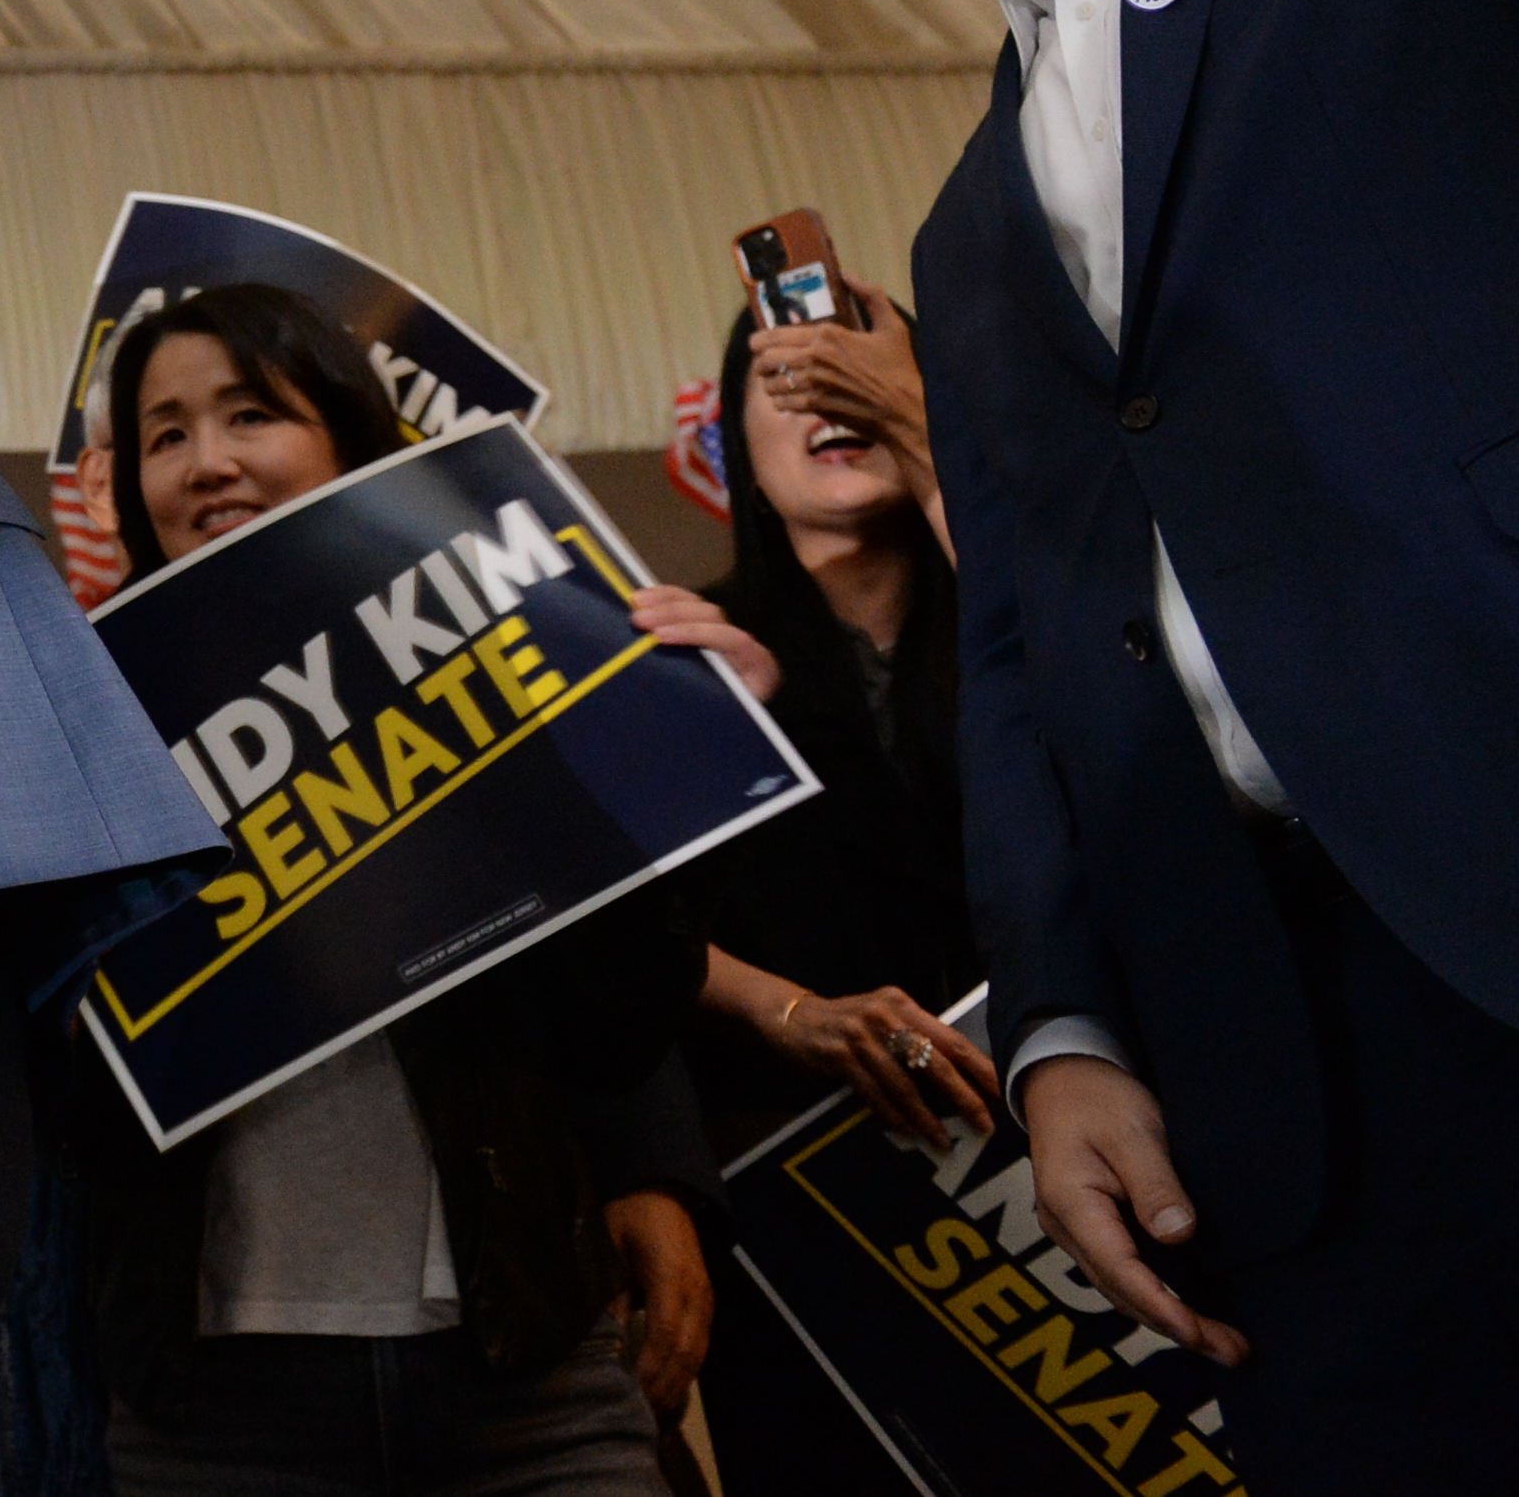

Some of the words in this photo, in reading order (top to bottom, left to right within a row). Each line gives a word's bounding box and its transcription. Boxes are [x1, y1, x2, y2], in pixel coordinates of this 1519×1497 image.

[354, 498, 575, 686] KIM
[197, 614, 568, 940] SENATE
[893, 1217, 1252, 1497] SENAT
